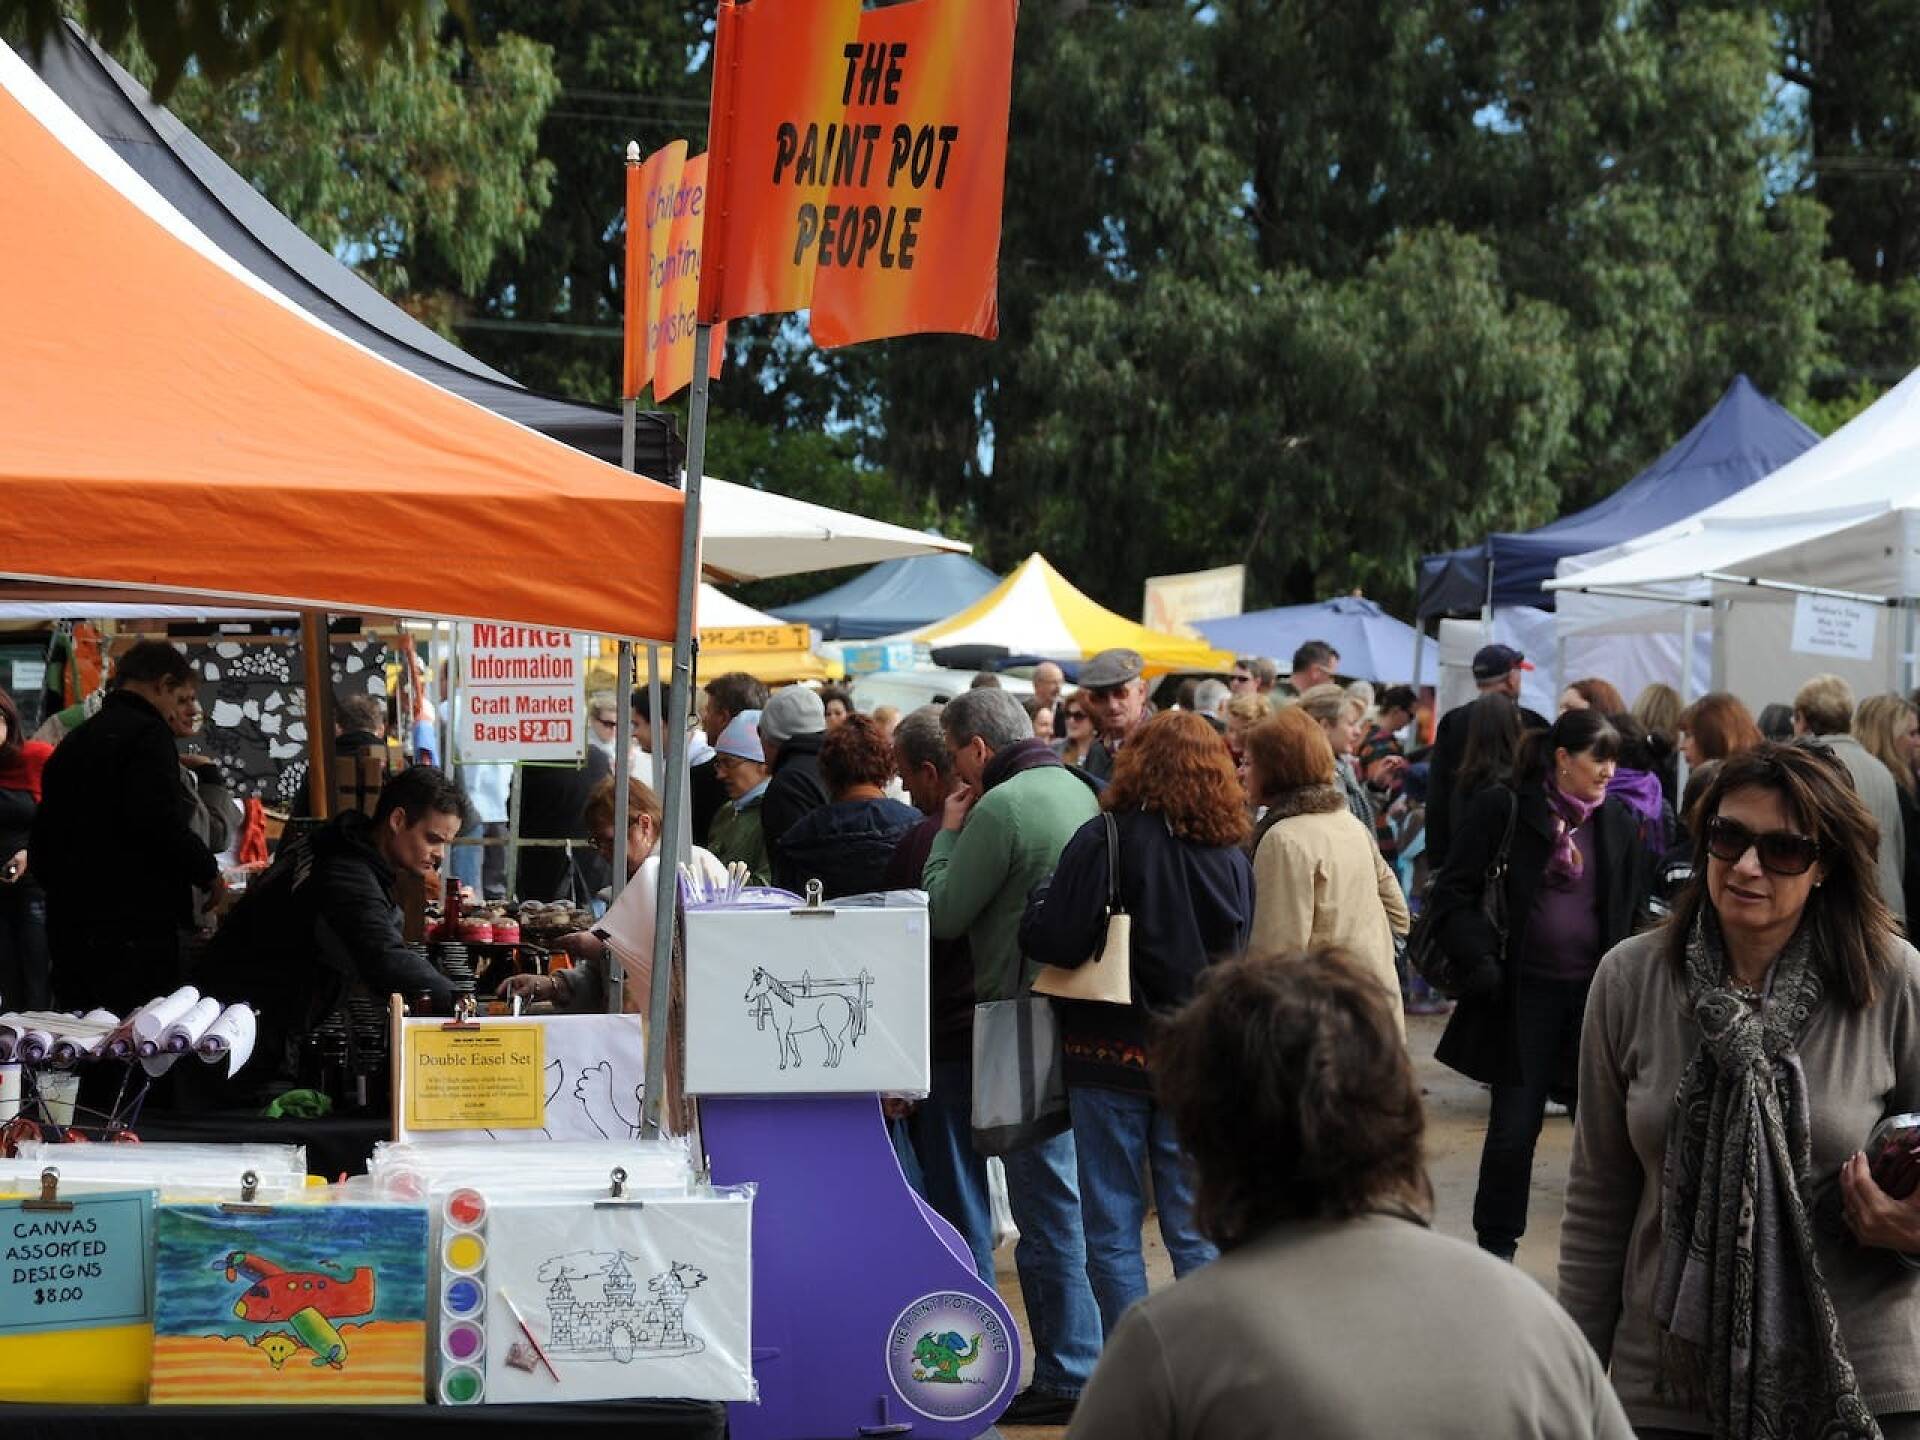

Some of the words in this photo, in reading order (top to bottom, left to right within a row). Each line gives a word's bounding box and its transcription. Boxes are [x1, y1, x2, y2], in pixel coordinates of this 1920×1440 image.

[842, 43, 907, 106] THE
[772, 122, 882, 188] PAINT
[887, 124, 958, 189] POT
[646, 178, 704, 229] Childre
[793, 203, 922, 270] PEOPLE
[648, 240, 701, 289] Paintin
[473, 623, 572, 648] Market
[471, 654, 573, 679] Information
[471, 696, 510, 715] Craft
[516, 696, 574, 715] Market
[474, 722, 517, 743] Bags
[522, 720, 569, 741] $2.00
[419, 1052, 467, 1066] Double
[471, 1051, 505, 1066] Easel
[510, 1051, 531, 1066] Set
[13, 1218, 97, 1238] CANVAS
[5, 1240, 107, 1261] ASSORTED
[12, 1262, 103, 1284] DESIGNS
